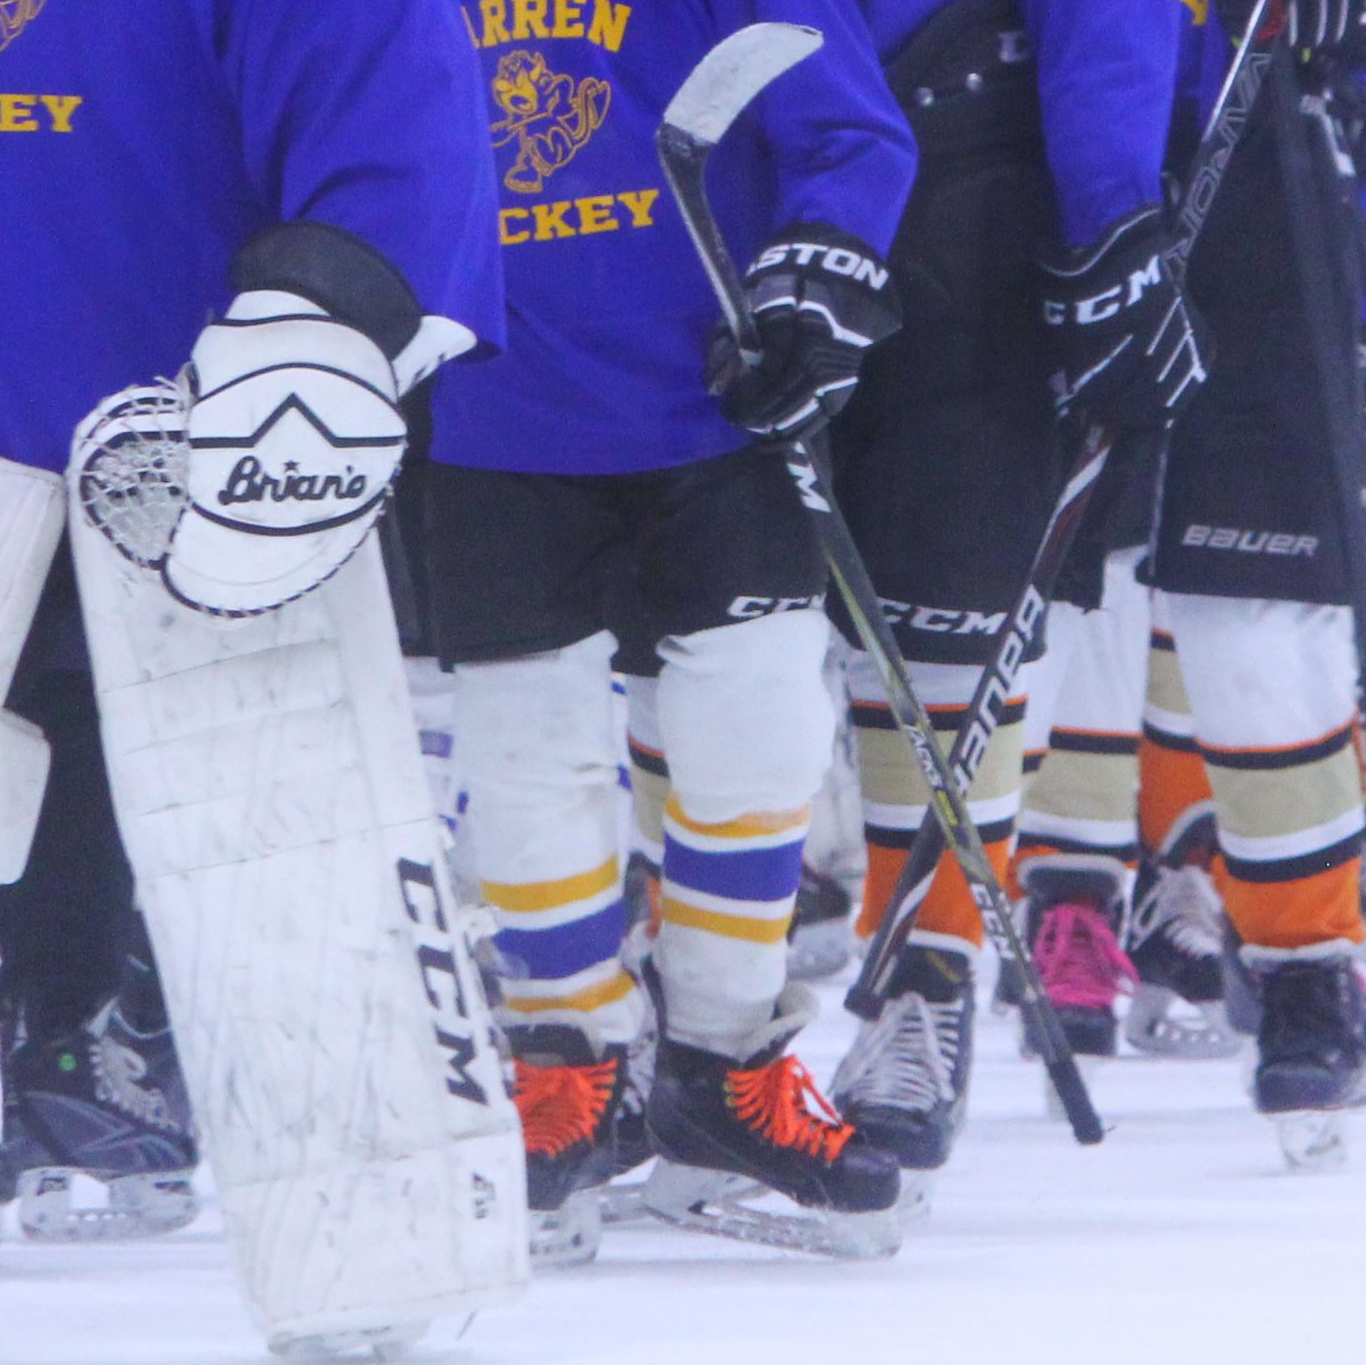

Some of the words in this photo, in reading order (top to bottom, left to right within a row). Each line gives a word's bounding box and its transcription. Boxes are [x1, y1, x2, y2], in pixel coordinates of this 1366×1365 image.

[498, 188, 660, 245] CKEY
[745, 243, 889, 291] STON
[1043, 254, 1162, 325] CCM
[1181, 523, 1320, 558] BAUER
[397, 857, 489, 1108] CCM
